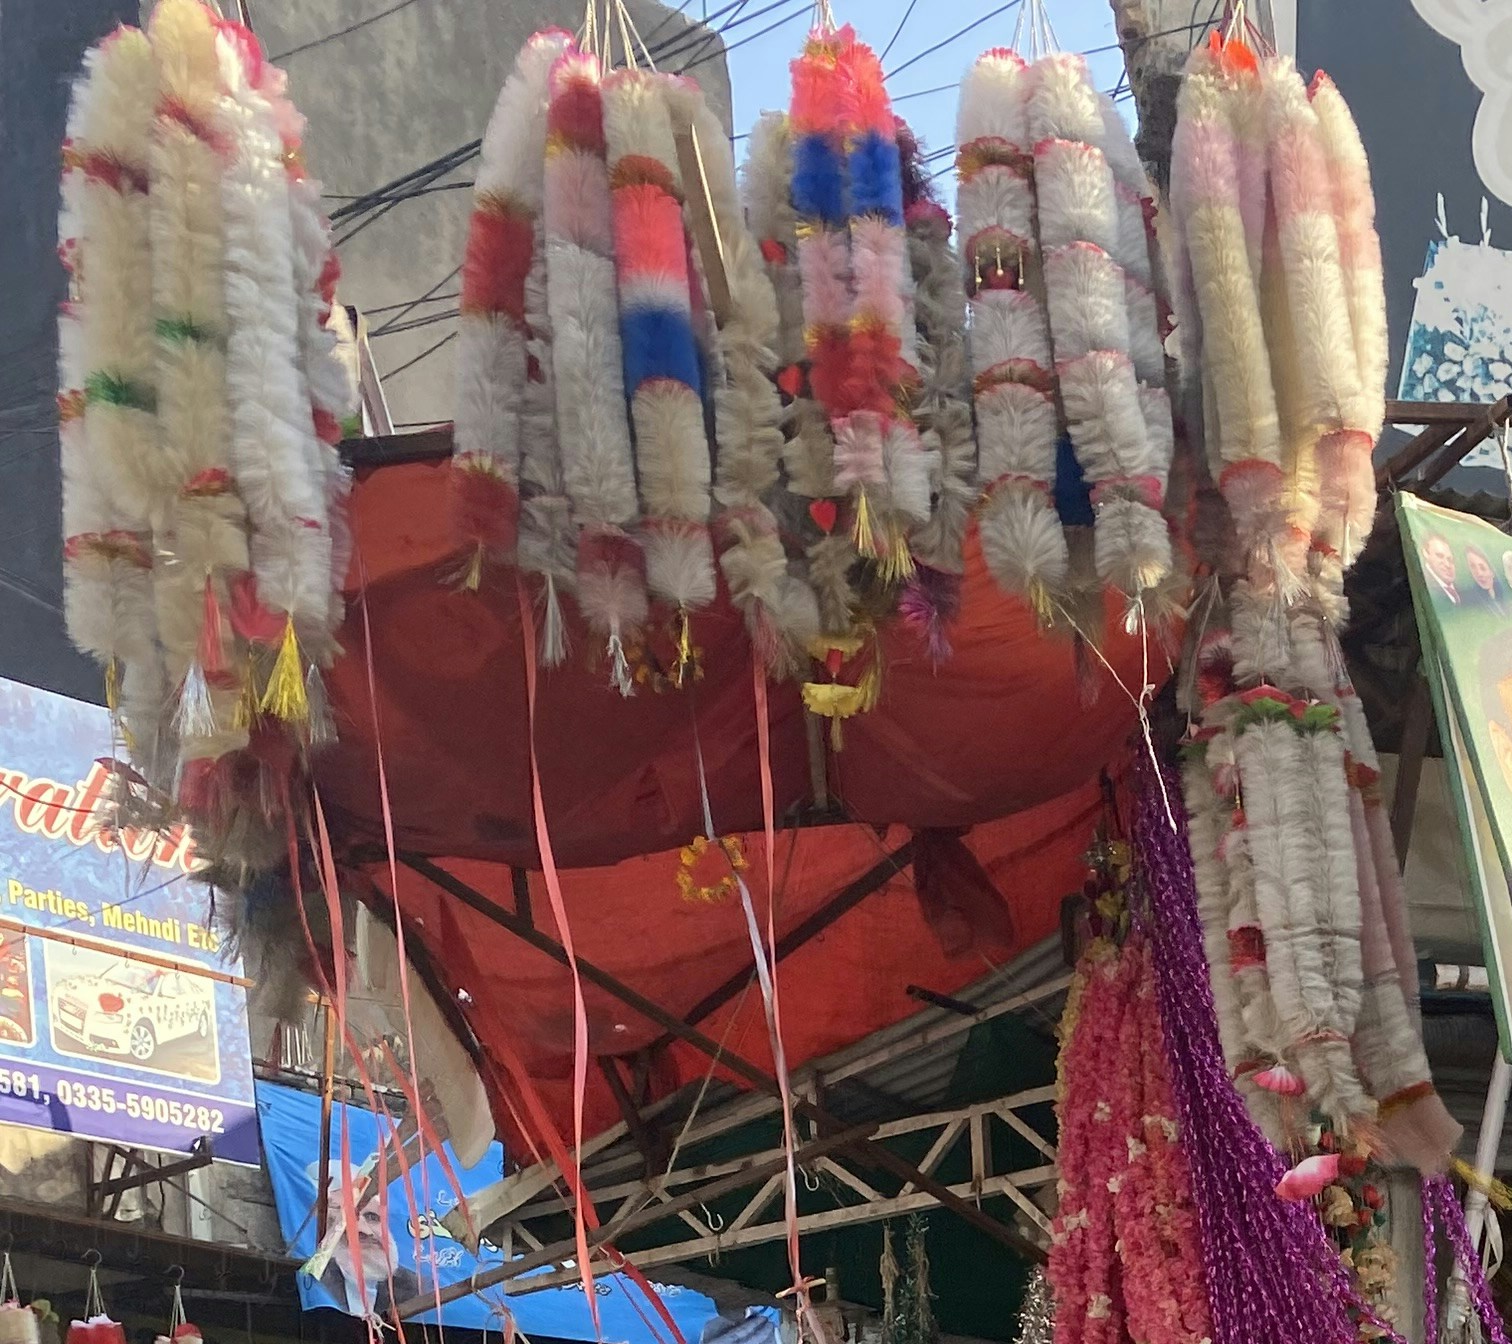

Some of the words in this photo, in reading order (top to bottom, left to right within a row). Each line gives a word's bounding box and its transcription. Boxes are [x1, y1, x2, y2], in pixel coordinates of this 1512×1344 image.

[8, 879, 97, 928] Parties,
[102, 902, 181, 944] Mehndi
[57, 1079, 226, 1134] 0335-5905282
